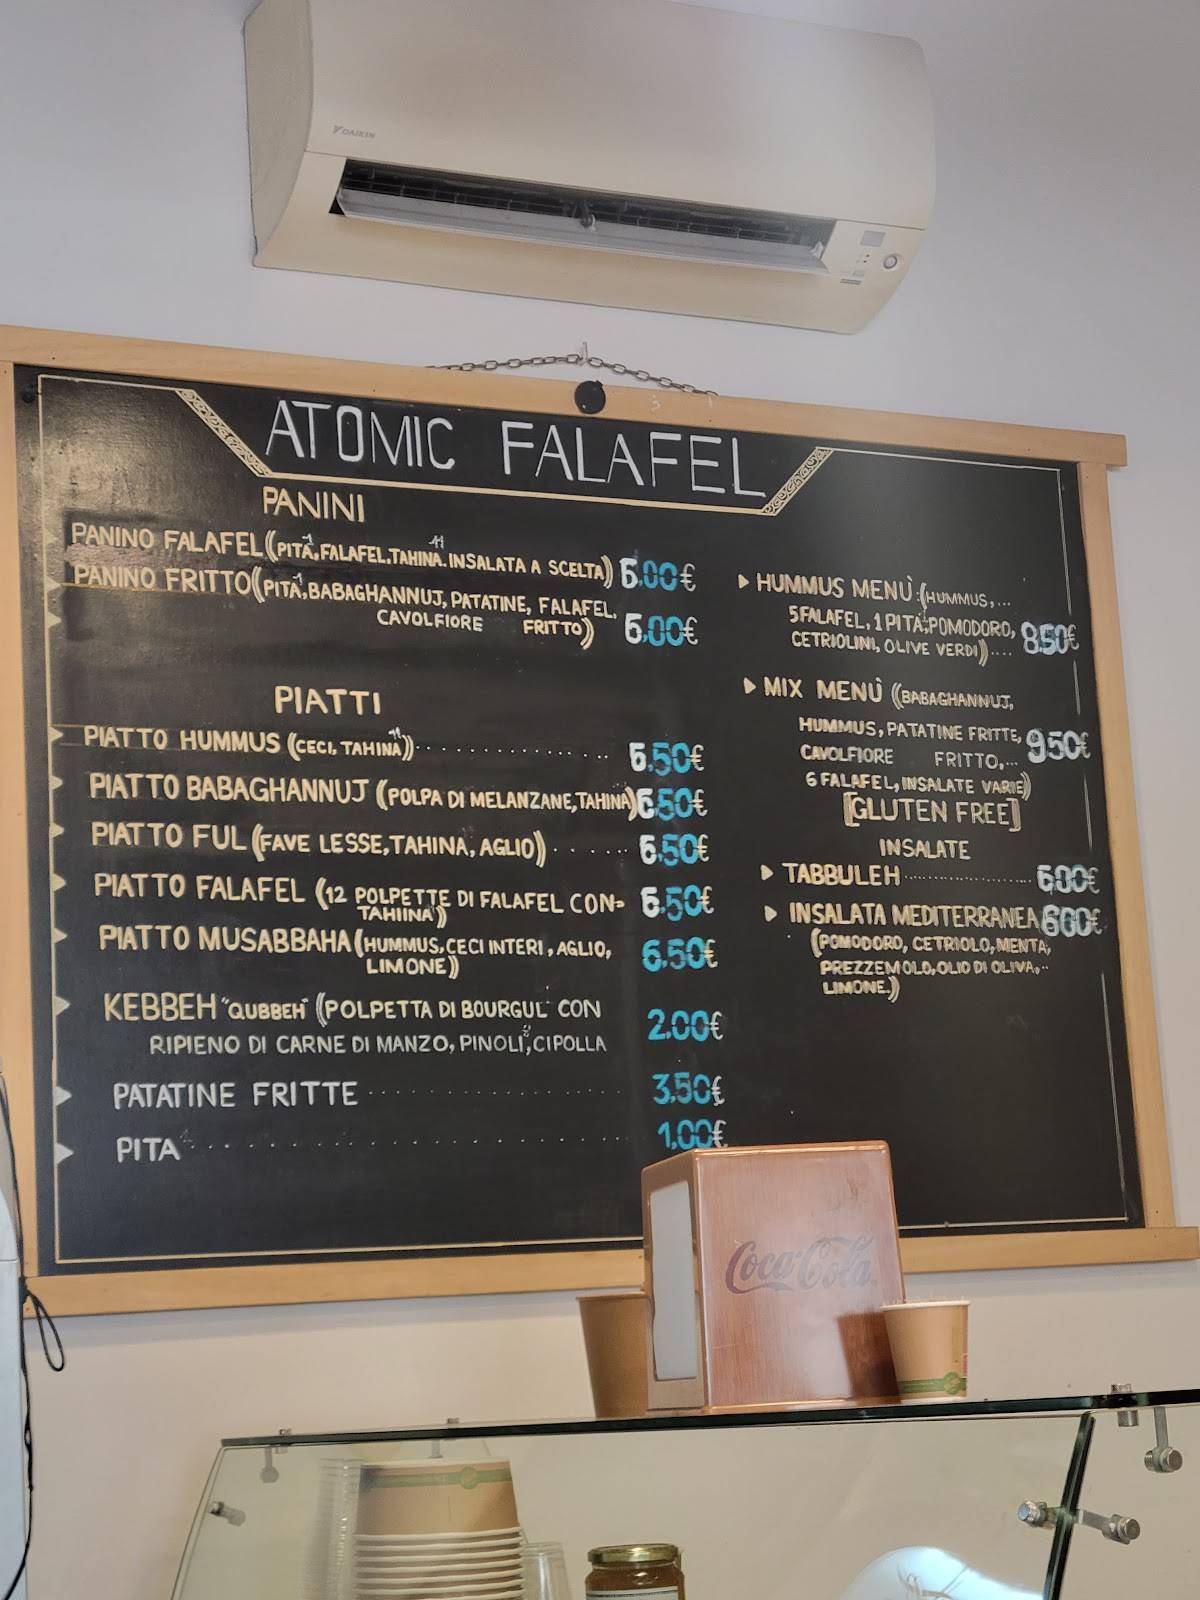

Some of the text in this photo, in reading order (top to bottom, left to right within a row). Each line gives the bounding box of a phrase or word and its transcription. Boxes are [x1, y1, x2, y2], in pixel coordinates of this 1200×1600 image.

[265, 399, 766, 498] ATOMIC FALAFEL
[262, 485, 365, 523] PANINI
[71, 522, 154, 549] PANINO
[163, 530, 263, 557] FALAFEL
[449, 553, 527, 573] INSALATA
[531, 559, 541, 575] A
[74, 564, 155, 589] PANINO
[166, 567, 250, 595] FRITTO
[756, 572, 845, 598] HUMMUS
[377, 609, 484, 632] CAVOLFIORE
[884, 638, 930, 656] OLIVE
[274, 685, 382, 716] PIATTI
[763, 676, 803, 699] MIX
[83, 725, 169, 750] PIATTO
[179, 729, 281, 755] HUMMUS
[887, 721, 963, 742] PATATINE
[800, 743, 894, 765] CAVOLFIORE
[88, 772, 180, 801] PIATTO
[186, 775, 370, 805] BABAGHANNUJ
[447, 790, 465, 809] DI
[901, 776, 975, 795] INSALATE
[91, 821, 184, 848] PIATTO
[192, 823, 248, 851] FUL
[879, 838, 971, 860] INSALATE
[781, 862, 901, 887] TABBULEH
[94, 872, 186, 898] PIATTO
[196, 874, 306, 903] FALAFEL
[354, 887, 451, 907] POLPETTE
[457, 889, 474, 907] DI
[479, 891, 564, 914] FALAFEL
[789, 902, 887, 926] INSALATA
[891, 904, 1041, 930] MEDITERRANEA
[99, 924, 190, 950] PIATTO
[198, 926, 352, 954] MUSABBAHA
[445, 938, 484, 955] CECI
[973, 961, 988, 975] DI
[103, 992, 217, 1022] KEBBEH
[438, 1002, 457, 1019] DI
[461, 1000, 549, 1020] BOURGUL
[557, 999, 602, 1019] CON
[149, 1035, 241, 1055] RIPIENO
[248, 1035, 267, 1054] DI
[276, 1034, 346, 1055] CARNE
[352, 1036, 370, 1053] DI
[532, 1034, 607, 1053] CIPOLLA
[113, 1081, 359, 1110] PATATINE FRITTE
[116, 1136, 181, 1163] PITA
